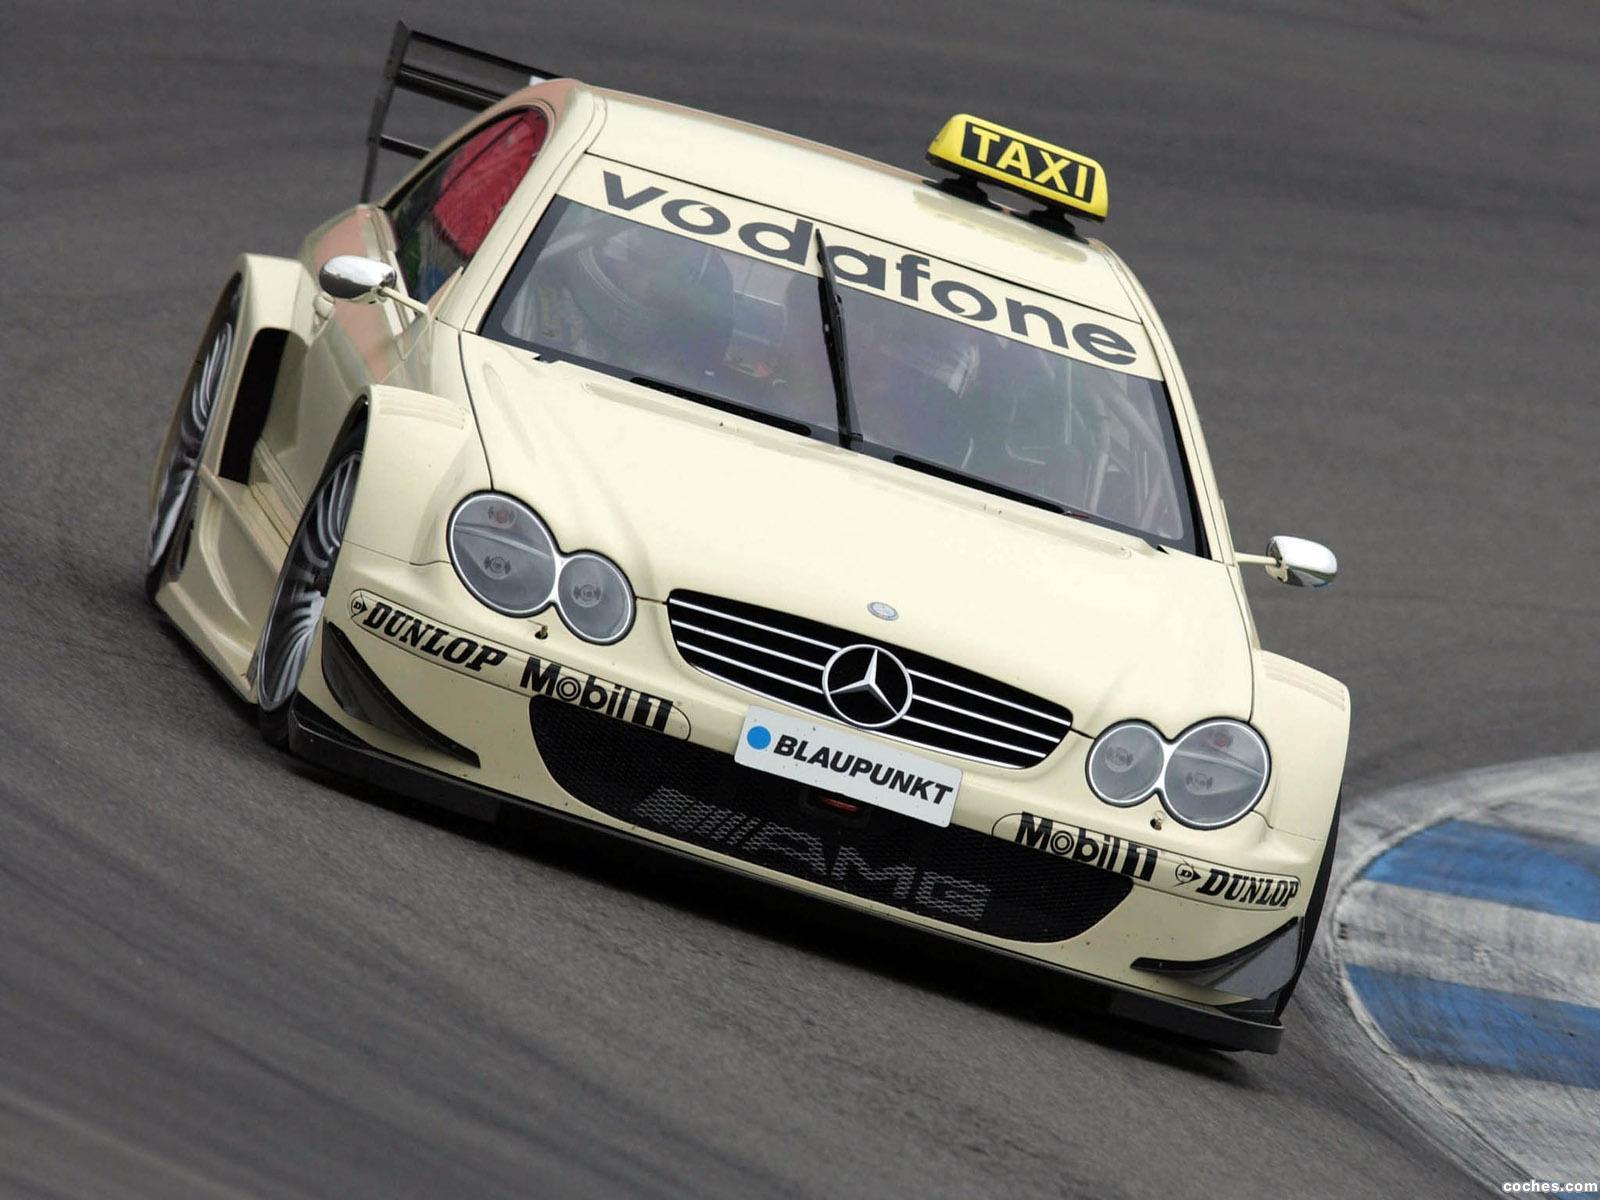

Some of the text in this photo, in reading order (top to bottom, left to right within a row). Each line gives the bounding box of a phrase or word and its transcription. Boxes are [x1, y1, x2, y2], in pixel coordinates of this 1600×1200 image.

[971, 126, 1092, 198] TAXI
[603, 170, 1138, 365] vodafone
[363, 601, 508, 672] DUNLOP
[519, 656, 632, 719] Mobil
[773, 734, 953, 806] BLAUPUNKT
[743, 821, 991, 920] AMG
[1014, 811, 1121, 872] Mobil
[1195, 868, 1299, 908] DUNLOP
